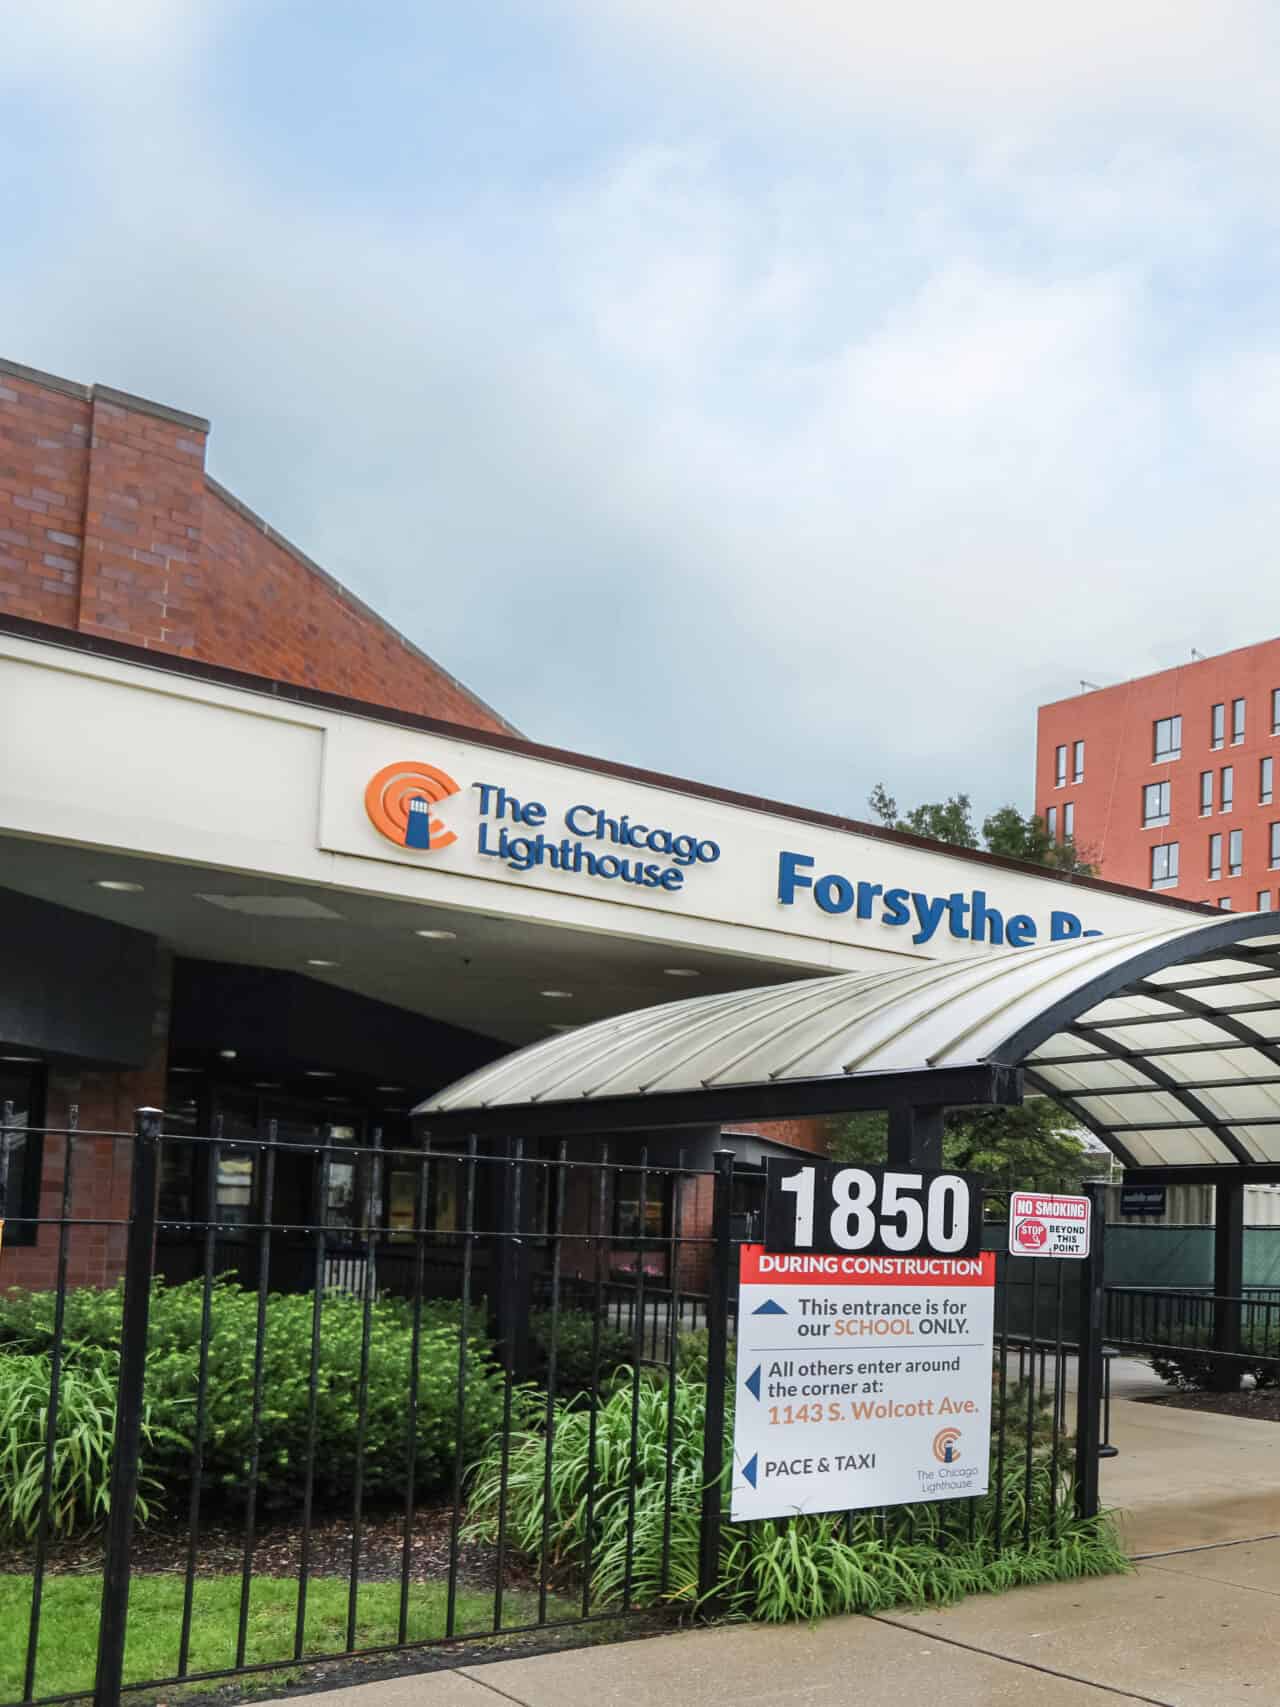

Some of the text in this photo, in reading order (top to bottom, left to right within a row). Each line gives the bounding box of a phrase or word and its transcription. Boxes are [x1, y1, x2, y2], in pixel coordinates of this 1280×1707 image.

[471, 782, 721, 866] The Chicago
[478, 822, 684, 891] Lighthouse
[777, 850, 1037, 948] Forsythe
[781, 1166, 970, 1253] 1850
[1017, 1199, 1085, 1218] NO SMOKING
[1022, 1225, 1044, 1236] STOP
[1049, 1225, 1085, 1234] BEYOND
[1057, 1234, 1077, 1243] THIS
[1053, 1244, 1080, 1252] POINT
[759, 1256, 983, 1276] DURING CONSTRUCTION
[799, 1299, 967, 1316] This entrance is for
[797, 1318, 969, 1337] our SCHOOL ONLY.
[768, 1356, 961, 1378] All others enter around
[768, 1378, 884, 1398] the corner at:
[768, 1396, 979, 1425] 1143 S. Wolcott Ave.
[765, 1454, 876, 1478] PACE & TAXI
[917, 1467, 979, 1480] The Chicago
[921, 1479, 973, 1494] Lighthouse
